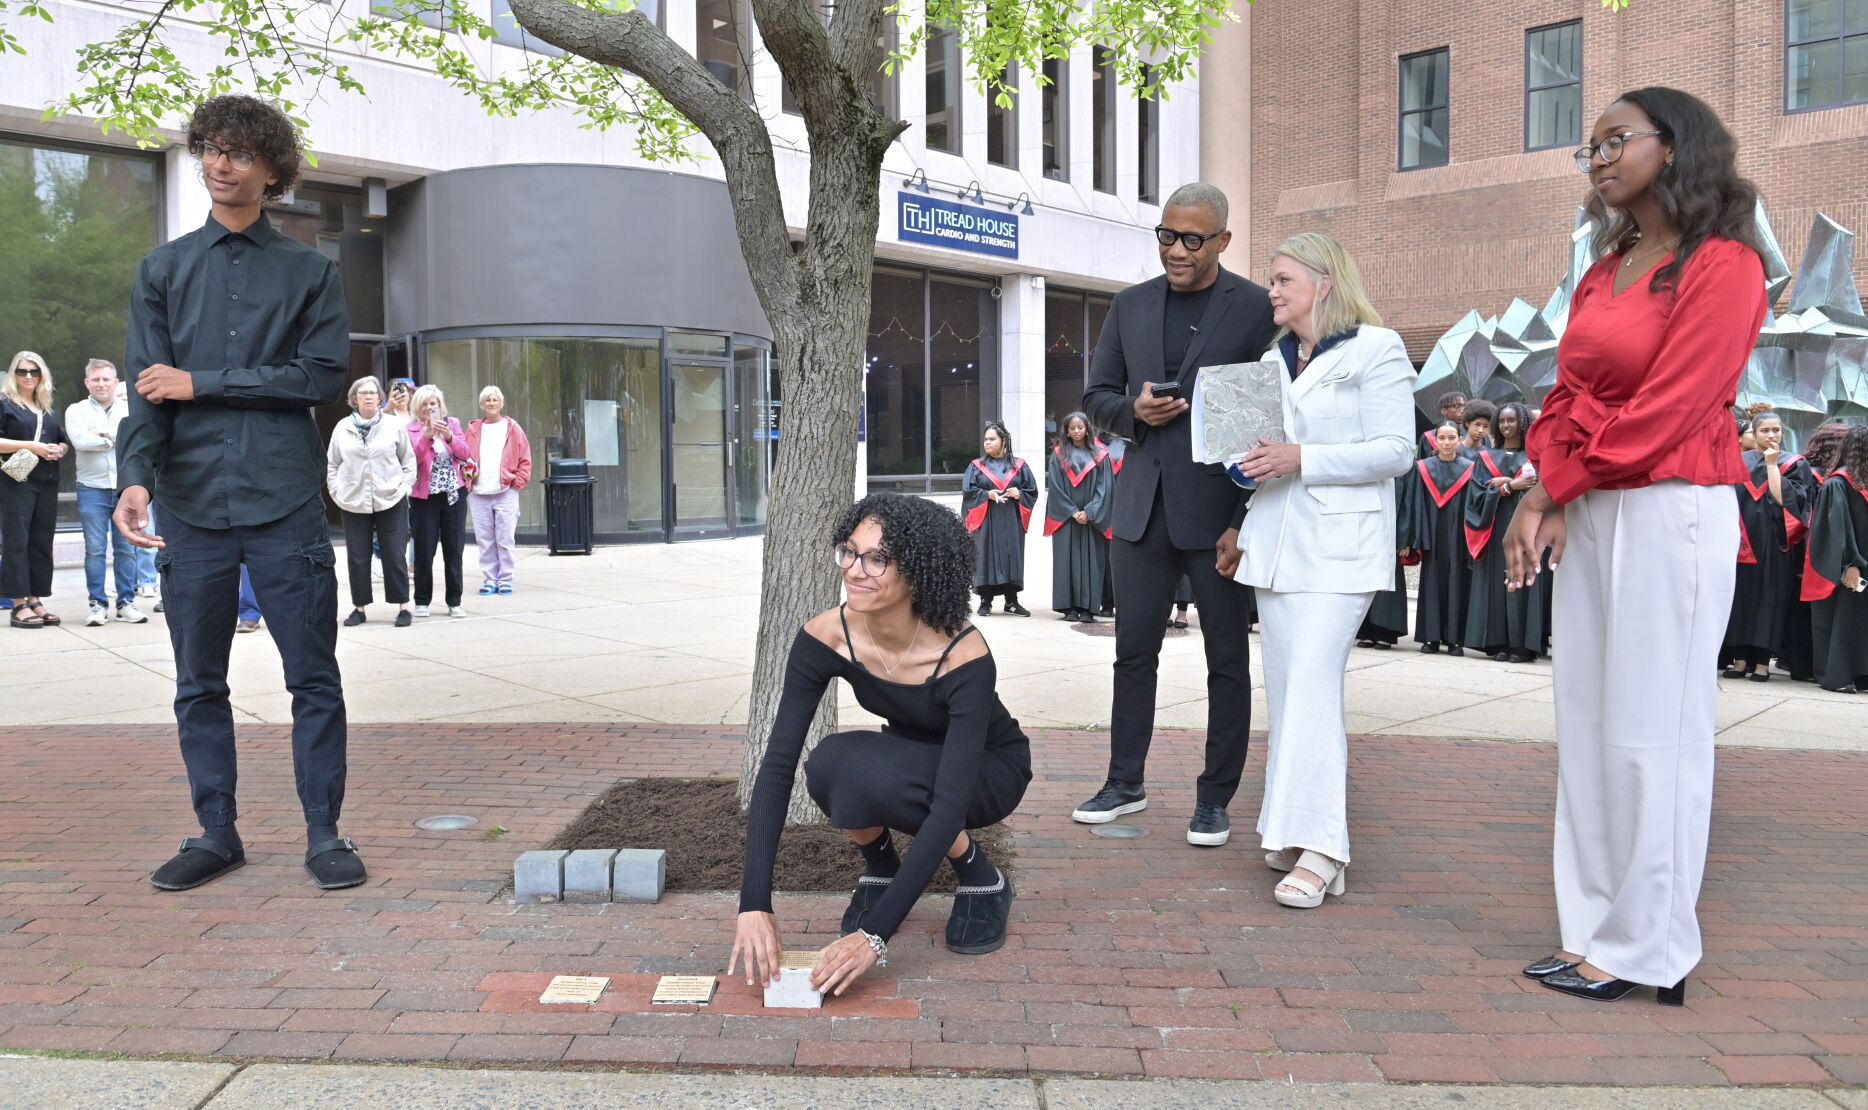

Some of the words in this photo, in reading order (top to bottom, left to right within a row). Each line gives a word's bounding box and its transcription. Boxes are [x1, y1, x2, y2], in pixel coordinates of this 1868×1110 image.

[907, 208, 930, 230] TH
[936, 209, 974, 230] TREAD
[977, 216, 1016, 238] HOUSE
[935, 228, 963, 240] CARDIO
[964, 232, 980, 243] AND
[981, 235, 1016, 250] STRENGTH
